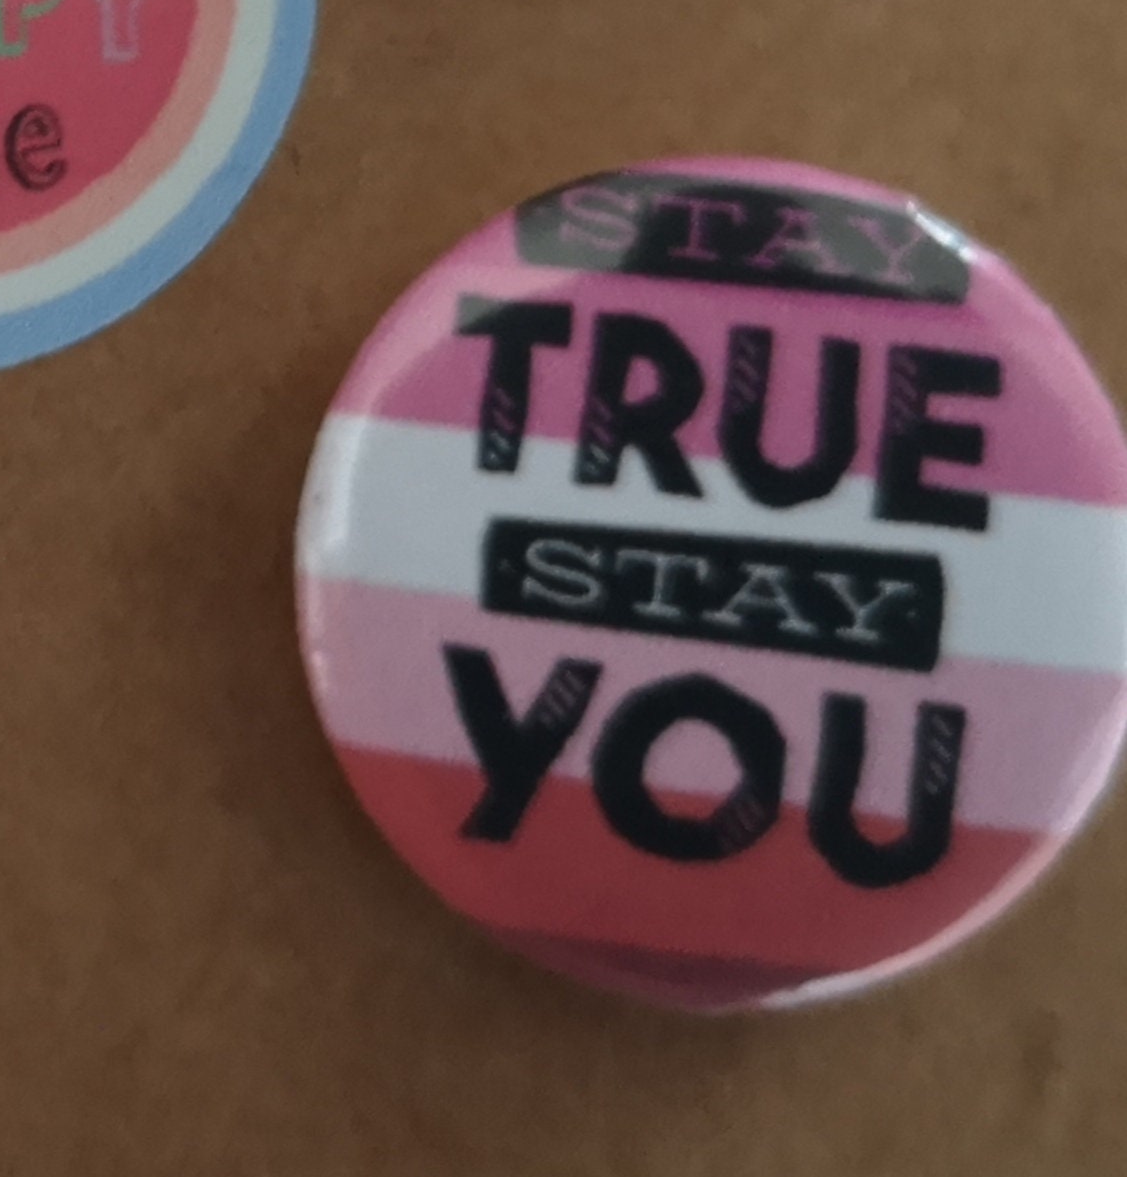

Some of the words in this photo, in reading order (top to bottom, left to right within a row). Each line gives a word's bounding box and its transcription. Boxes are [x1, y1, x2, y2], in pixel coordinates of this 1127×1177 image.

[559, 186, 933, 286] STAY
[454, 294, 1004, 533] TRUE
[520, 538, 916, 642] STAY
[442, 642, 967, 891] YOU
